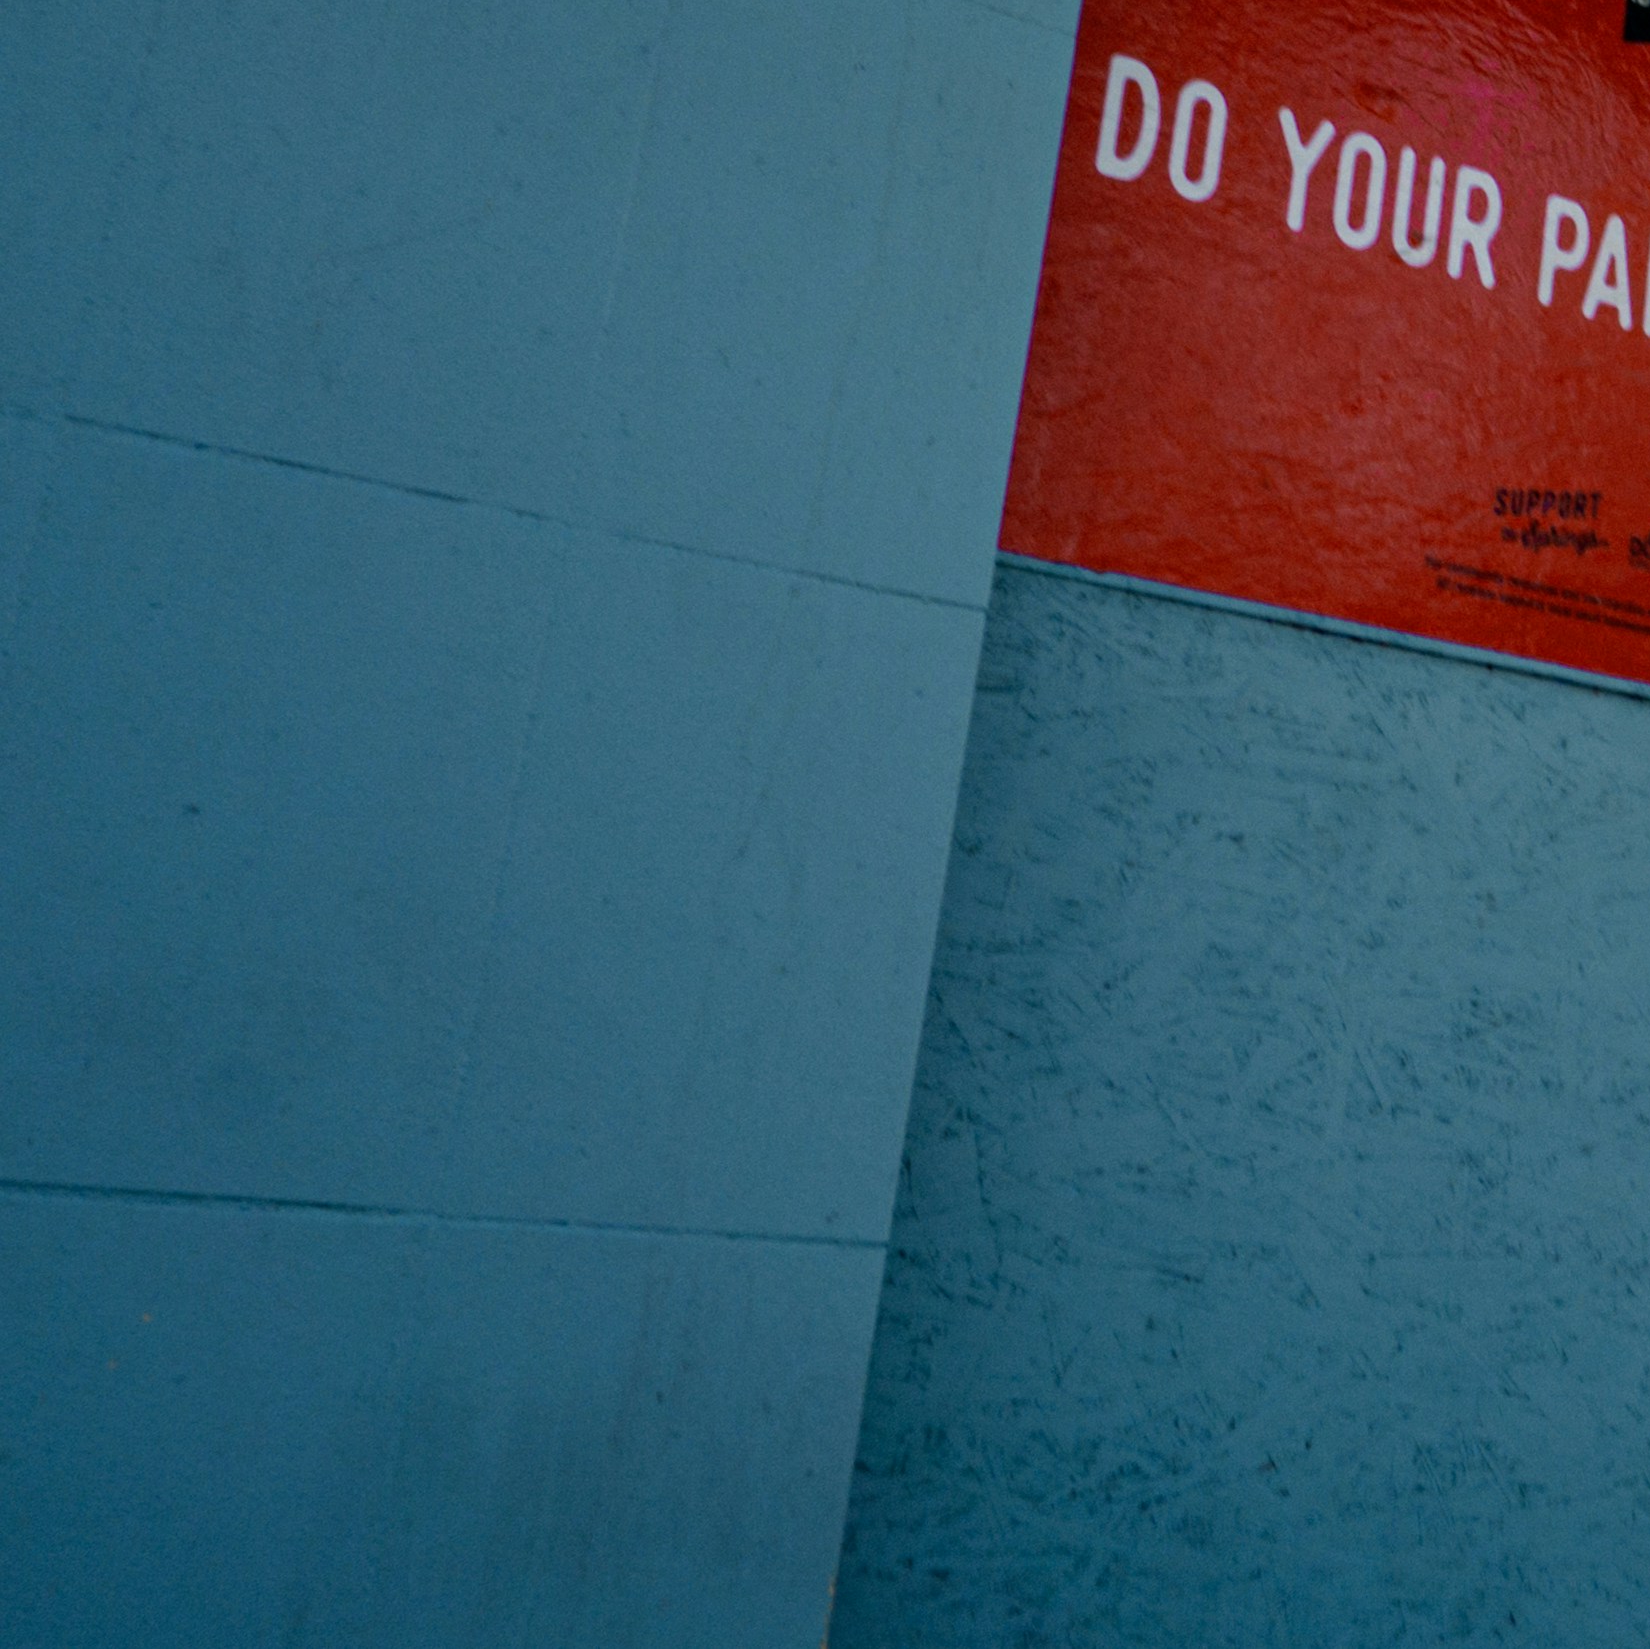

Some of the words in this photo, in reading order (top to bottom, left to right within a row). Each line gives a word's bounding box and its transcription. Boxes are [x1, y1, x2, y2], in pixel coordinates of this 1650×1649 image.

[1094, 54, 1229, 202] DO
[1277, 106, 1503, 291] YOUR
[1494, 487, 1602, 519] SUPPORT
